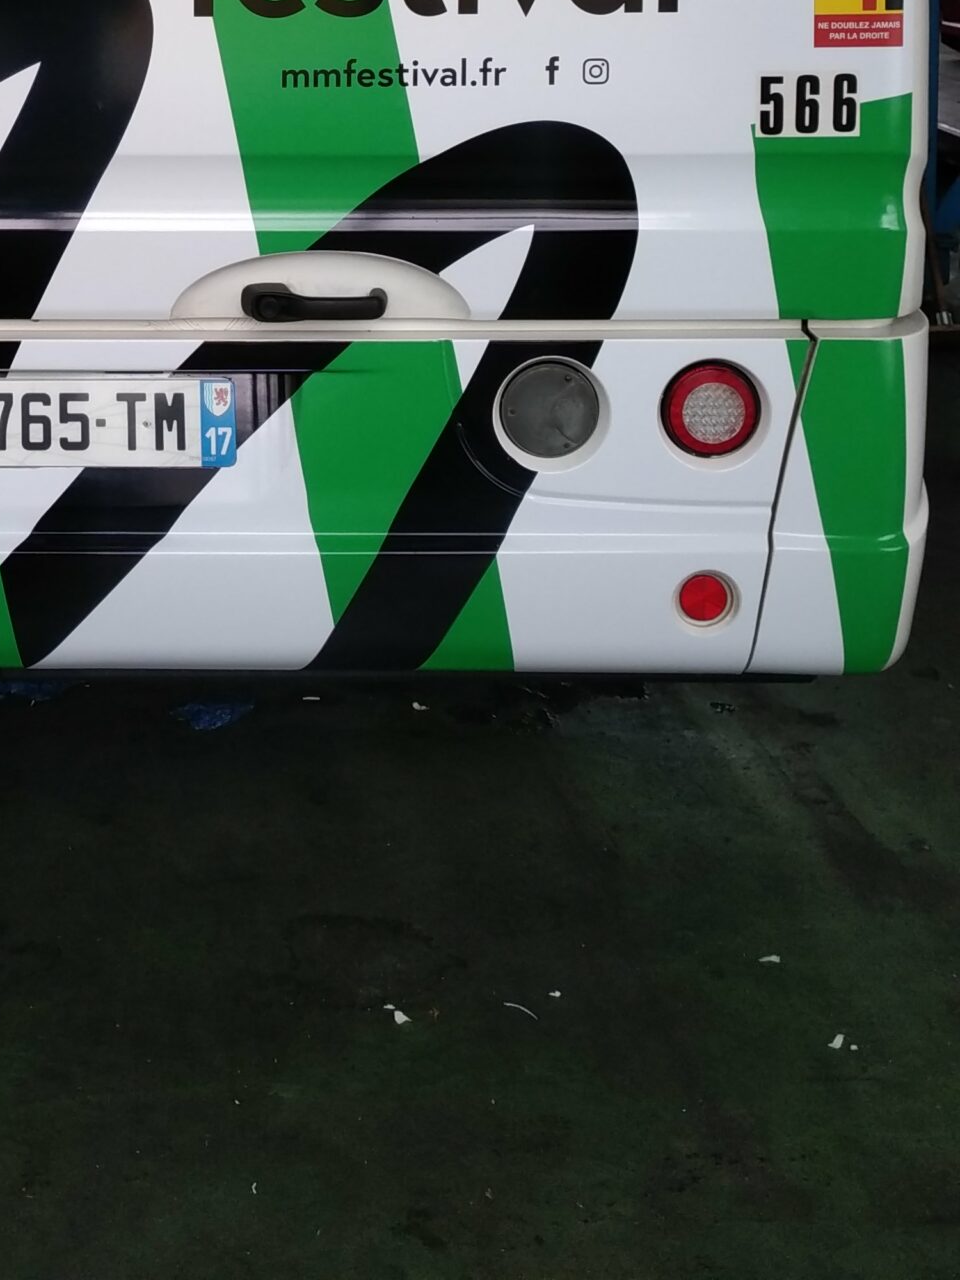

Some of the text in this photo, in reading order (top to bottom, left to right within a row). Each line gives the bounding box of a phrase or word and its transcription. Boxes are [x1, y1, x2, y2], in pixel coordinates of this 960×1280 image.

[281, 58, 506, 89] mmfestival.fr
[759, 72, 860, 136] 566
[204, 427, 232, 457] 17
